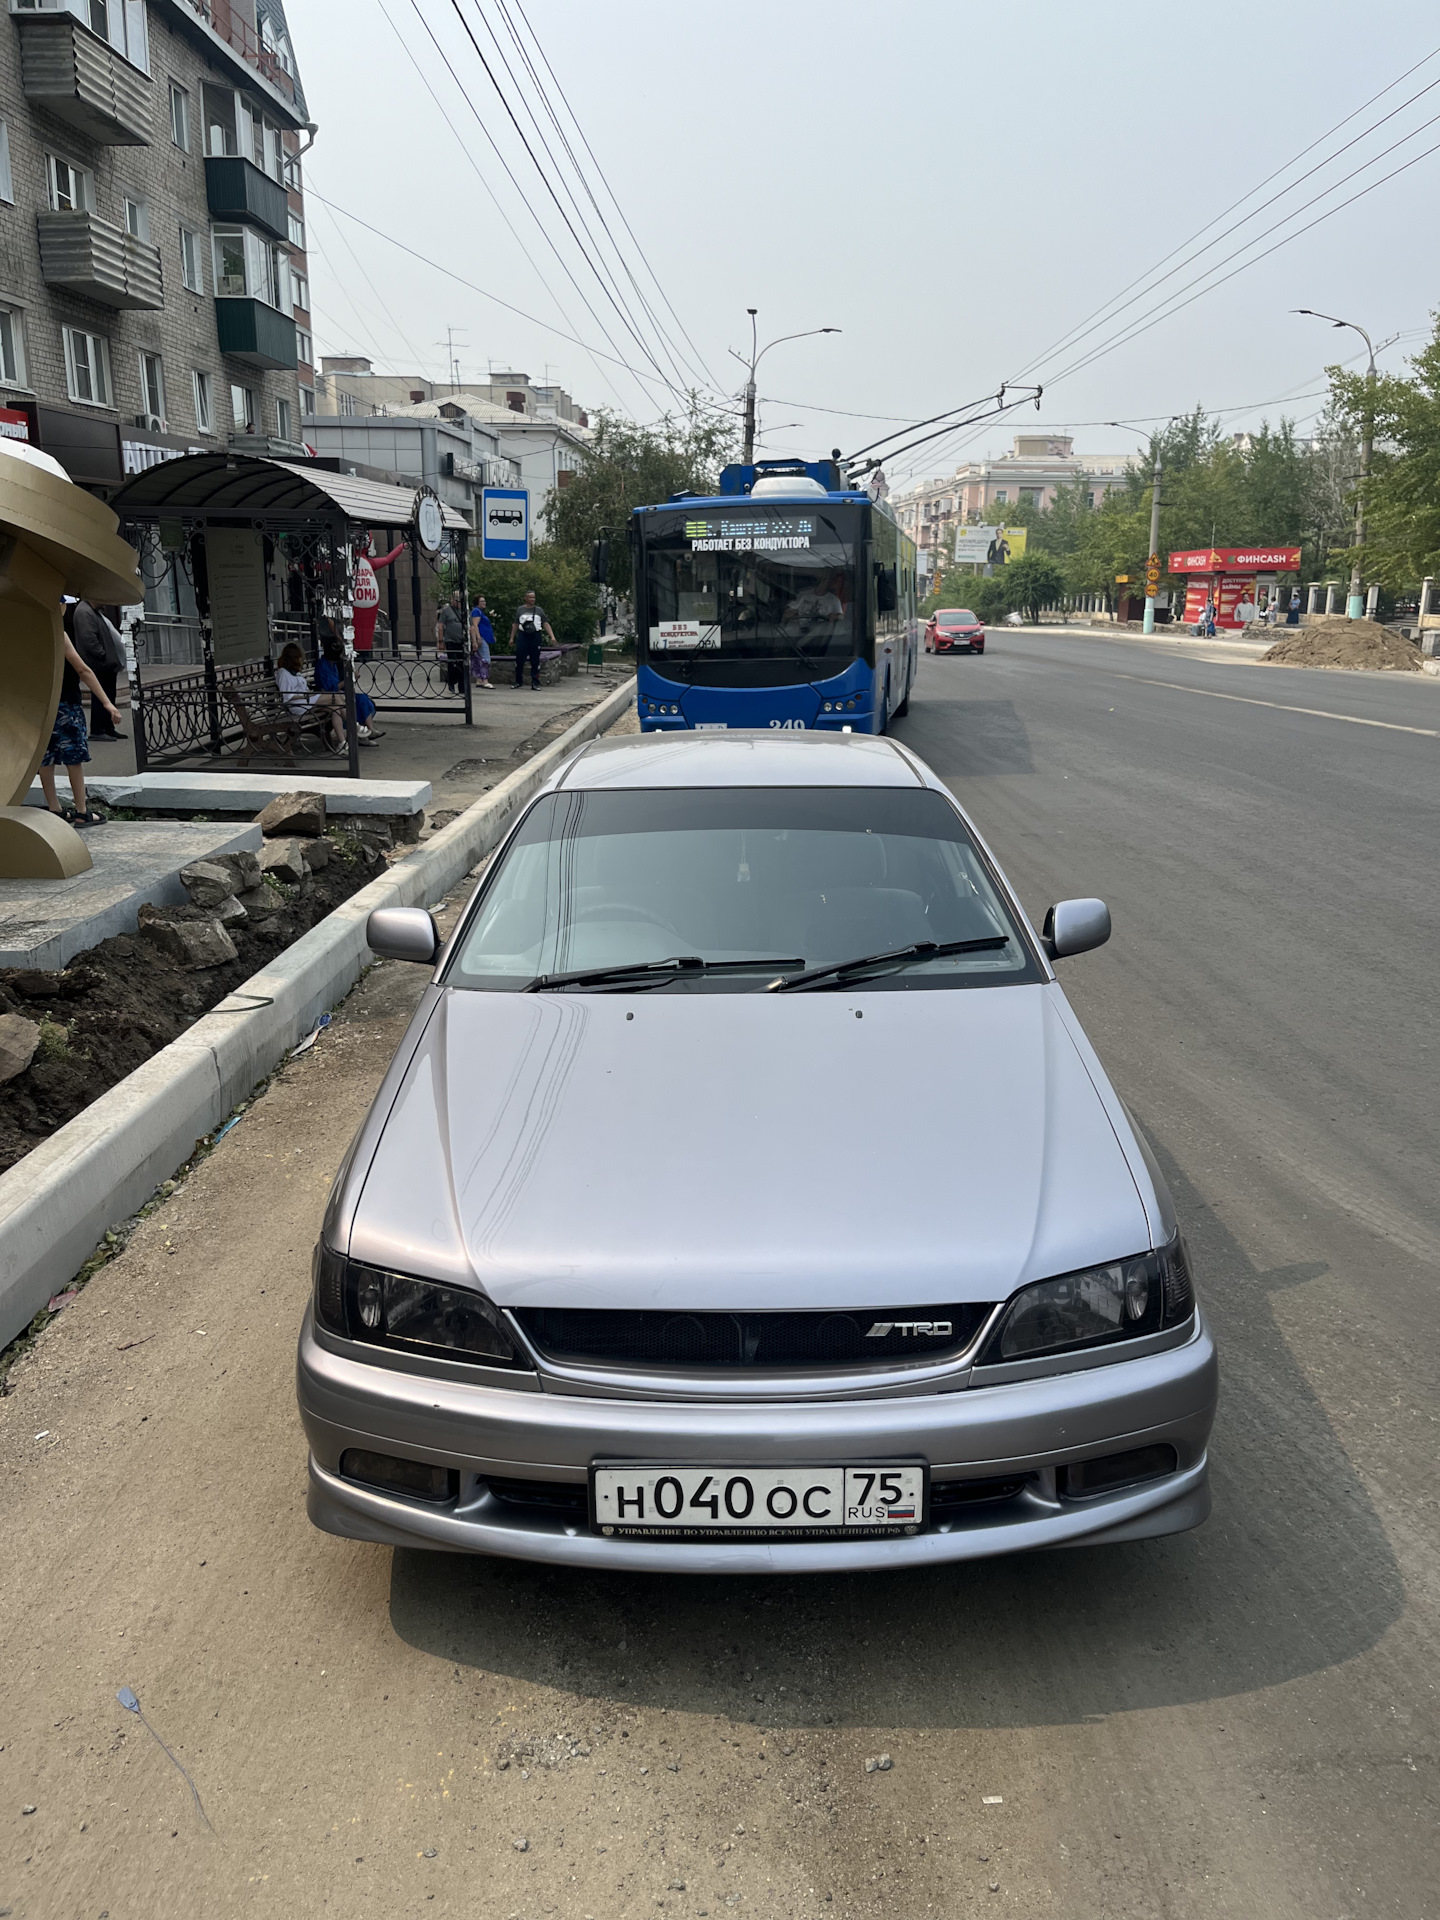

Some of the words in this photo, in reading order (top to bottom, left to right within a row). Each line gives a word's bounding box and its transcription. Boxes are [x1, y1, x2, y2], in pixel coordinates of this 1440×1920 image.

[691, 538, 733, 552] РАБОТАЕТ
[735, 537, 752, 550] БЕЗ
[754, 536, 810, 551] КОНДУКТОРА
[1236, 554, 1287, 564] ФИНCASH
[894, 1321, 953, 1337] TRD
[853, 1473, 902, 1506] 75
[848, 1507, 886, 1519] RUS
[618, 1527, 681, 1536] УПРАВЛЕНИЕ
[684, 1528, 698, 1536] ПО
[700, 1528, 767, 1537] УПРАВЛЕНИЮ
[769, 1528, 803, 1537] ВСЕМИ
[805, 1527, 886, 1536] УПРАВЛЕНИЯМИ
[887, 1526, 901, 1535] РФ
